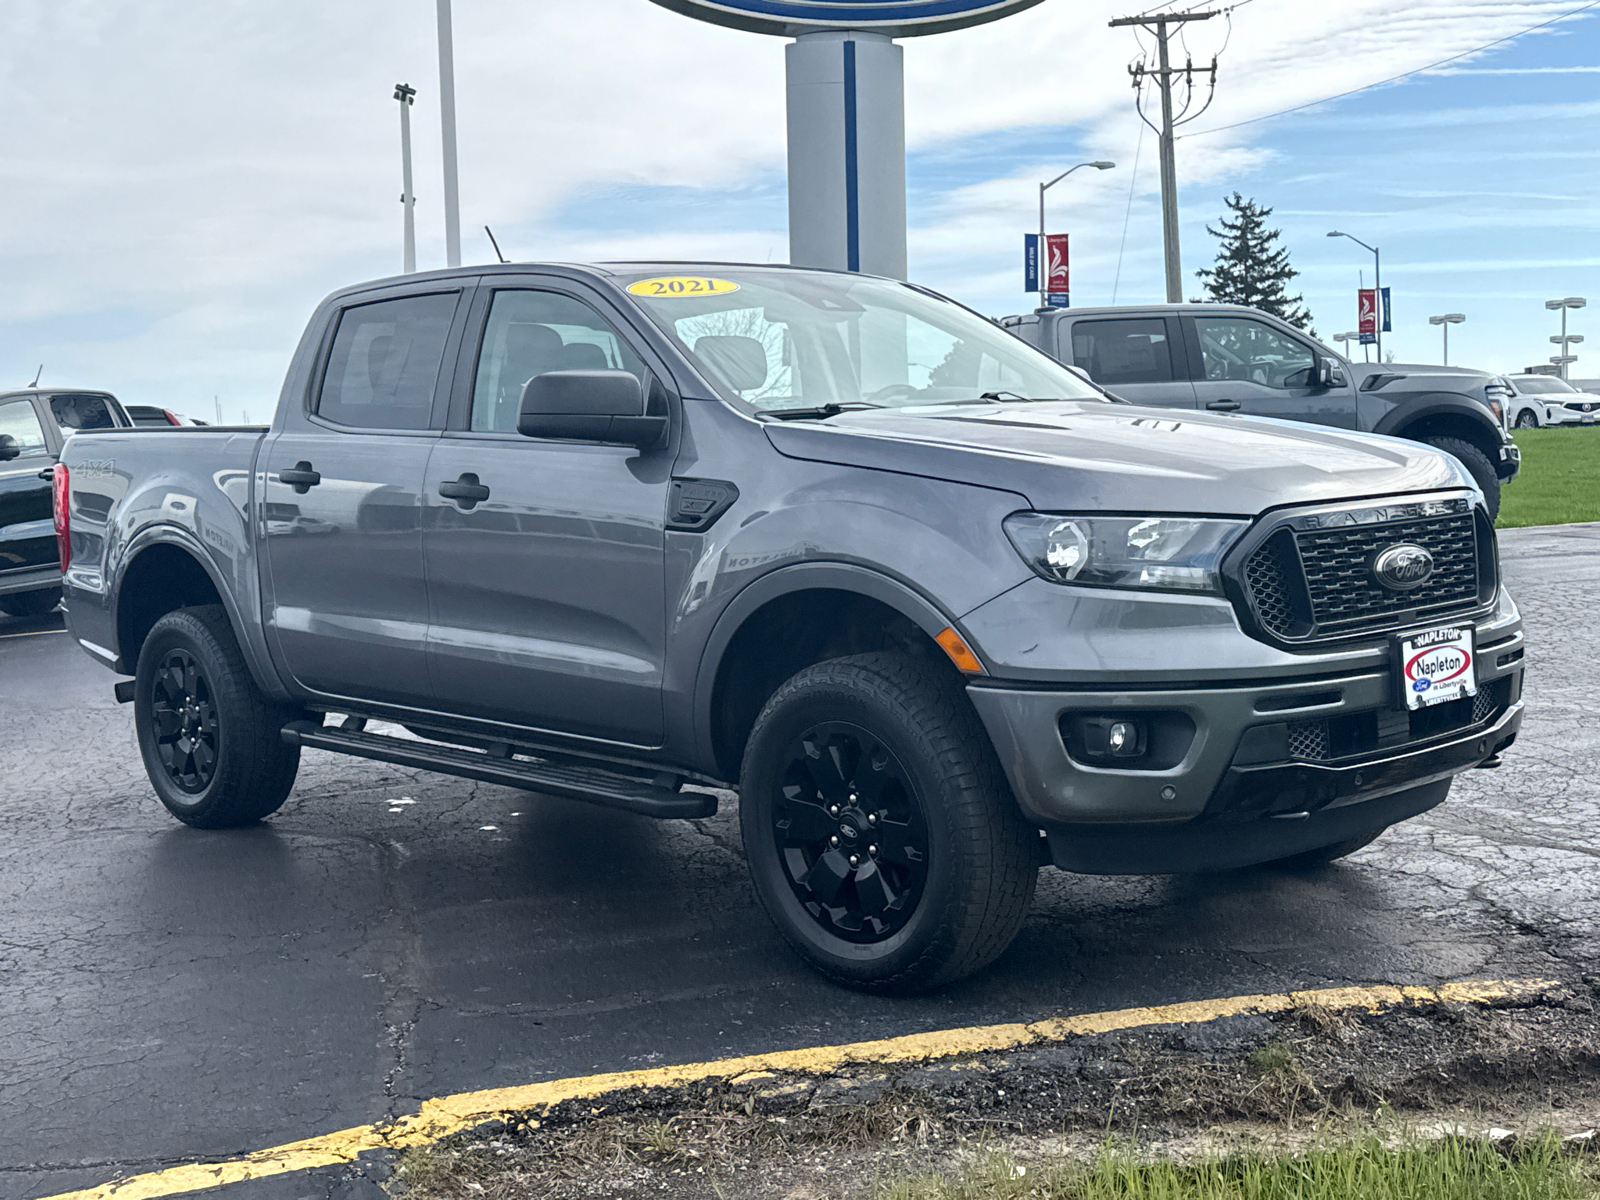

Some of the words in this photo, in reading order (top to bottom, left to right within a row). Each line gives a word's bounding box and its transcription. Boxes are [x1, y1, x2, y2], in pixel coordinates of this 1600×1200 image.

[650, 280, 718, 295] 2021
[1395, 553, 1426, 578] Ford
[1416, 656, 1461, 678] Napleton
[1415, 680, 1428, 691] Ford
